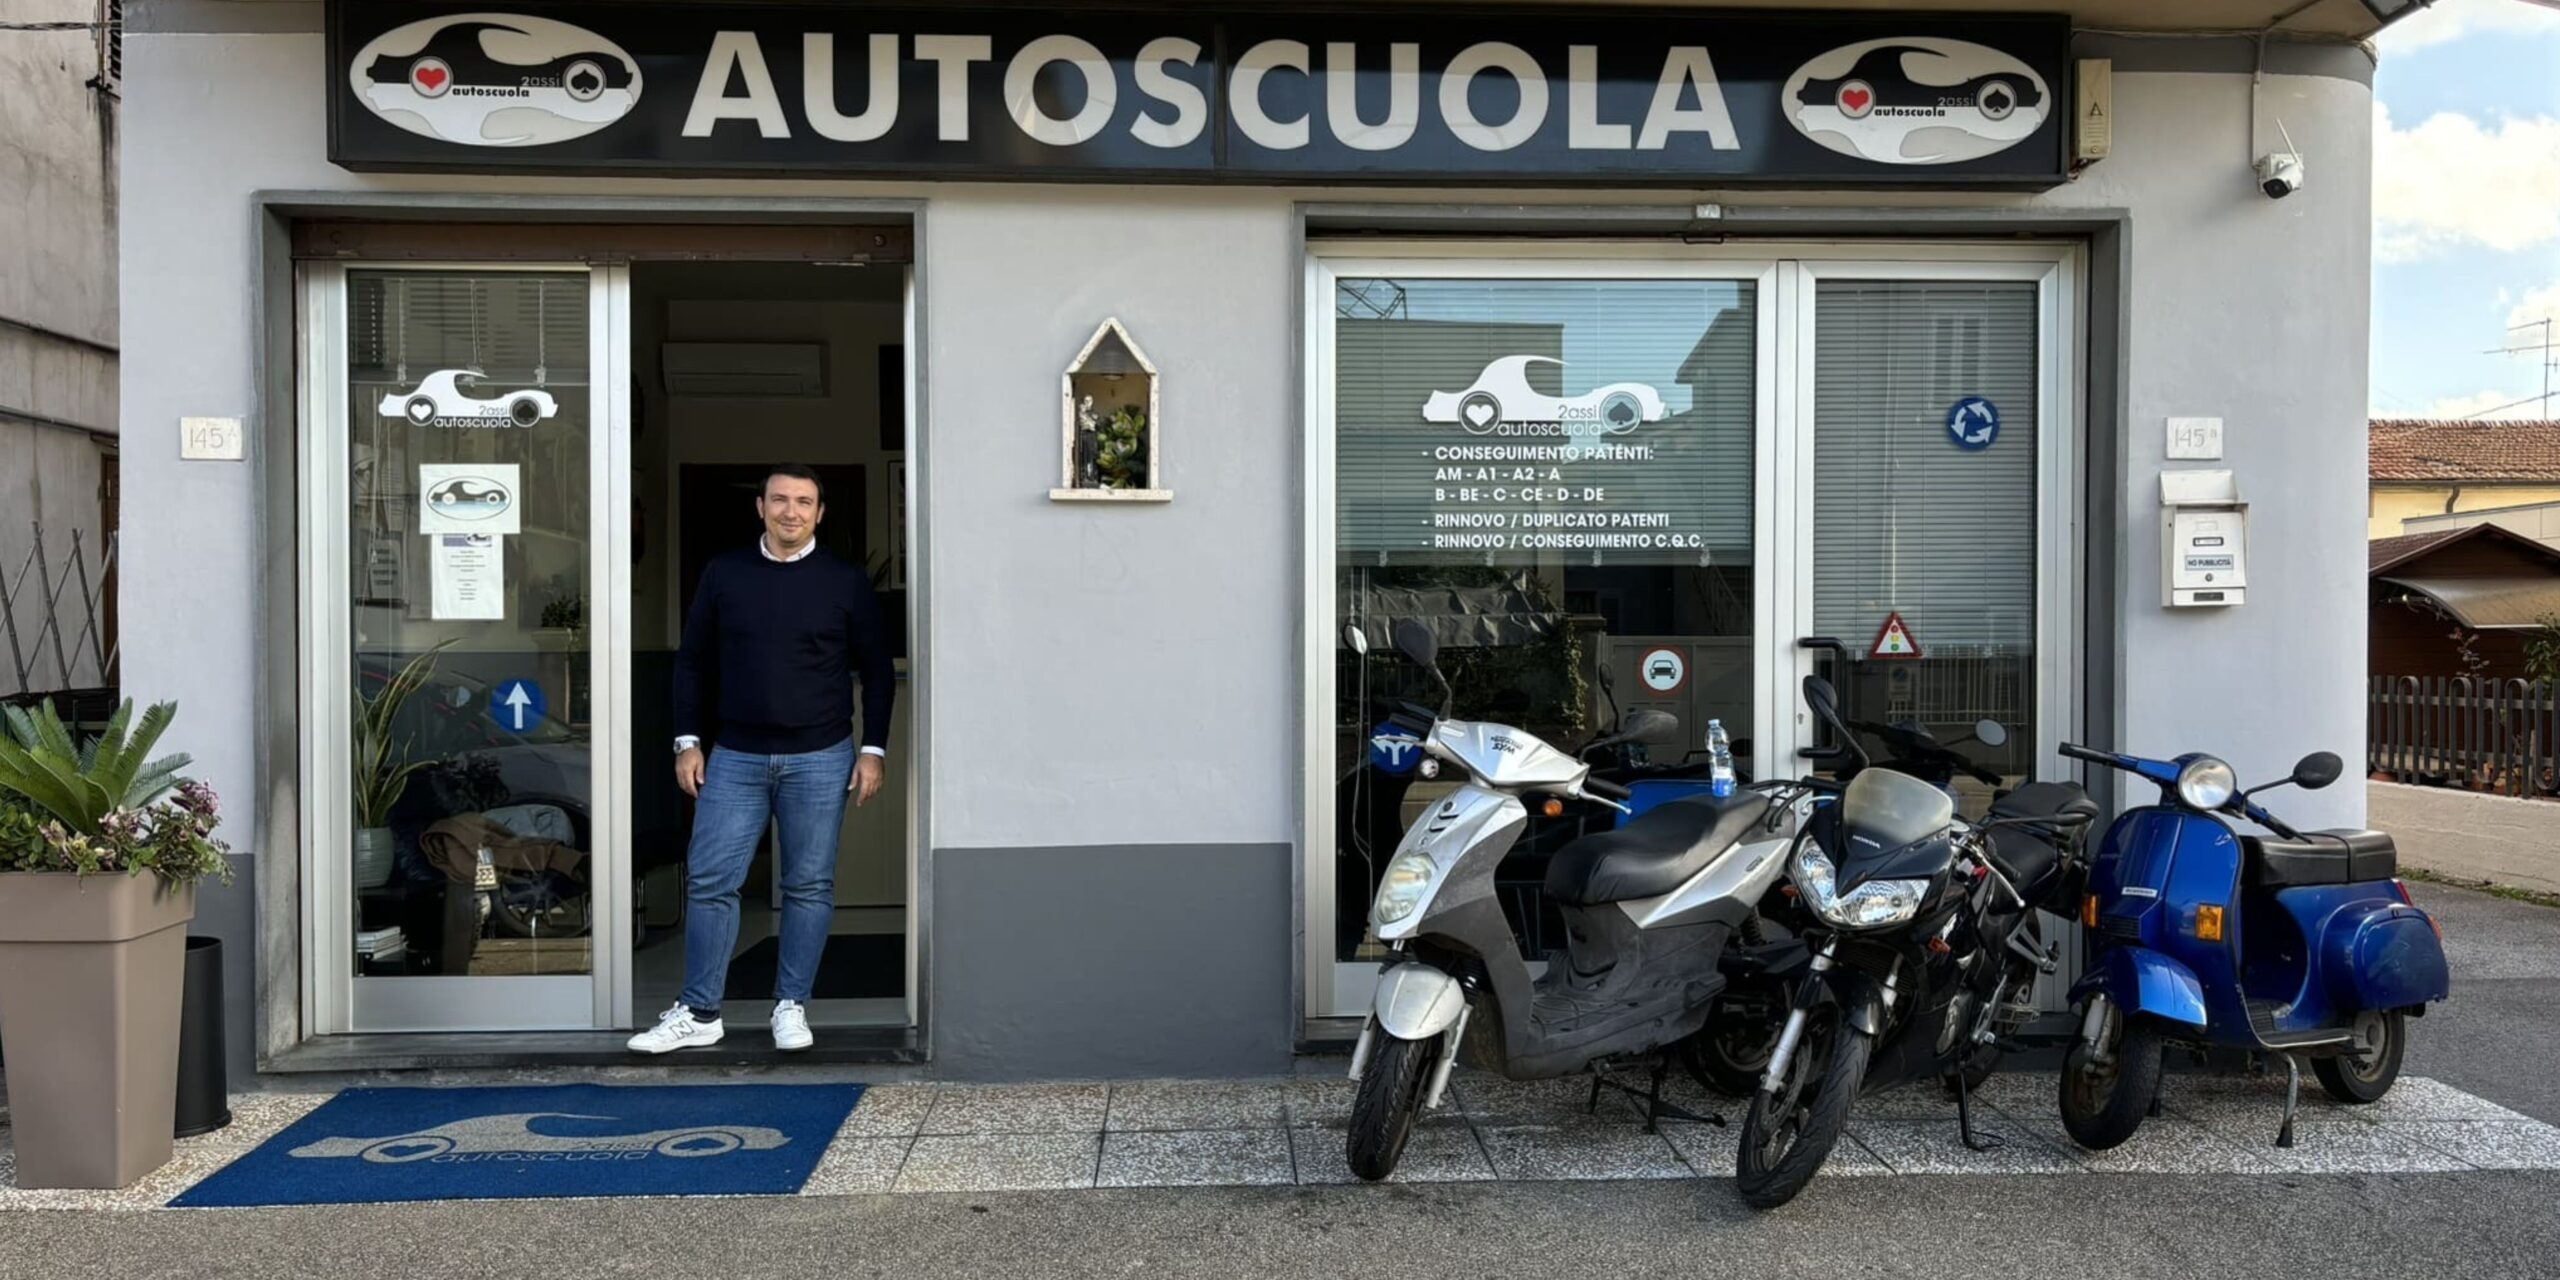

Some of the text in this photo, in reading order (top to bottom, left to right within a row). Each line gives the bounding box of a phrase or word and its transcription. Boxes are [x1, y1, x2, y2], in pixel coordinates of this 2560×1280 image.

[521, 72, 560, 87] 2assi
[452, 86, 530, 98] autoscuola
[681, 30, 1741, 152] AUTOSCUOLA
[1938, 92, 1974, 107] 2assi
[1874, 106, 1946, 117] autoscuola
[479, 404, 508, 416] 2assi
[1558, 403, 1598, 420] 2assi
[434, 416, 511, 428] autoscuola
[1497, 420, 1601, 437] autoscuola
[1435, 446, 1580, 460] CONSEGUIMENTO
[1584, 446, 1654, 460] PATENTI:
[1435, 467, 1462, 481] AM
[1476, 467, 1496, 481] A1
[1512, 467, 1534, 481] A2
[1549, 467, 1560, 481] A
[1435, 488, 1445, 501] B
[1460, 488, 1478, 501] BE
[1493, 487, 1506, 501] C
[1521, 487, 1543, 501] CE
[1557, 487, 1569, 501] D
[1584, 488, 1604, 501] DE
[1435, 513, 1505, 527] RINNOVO
[1523, 513, 1607, 527] DUPLICATO
[1611, 513, 1669, 527] PATENTI
[1435, 534, 1505, 548] RINNOVO
[1522, 534, 1651, 548] CONSEGUIMENTO
[1655, 534, 1704, 548] C.Q.C.
[430, 1150, 650, 1164] autoscuola
